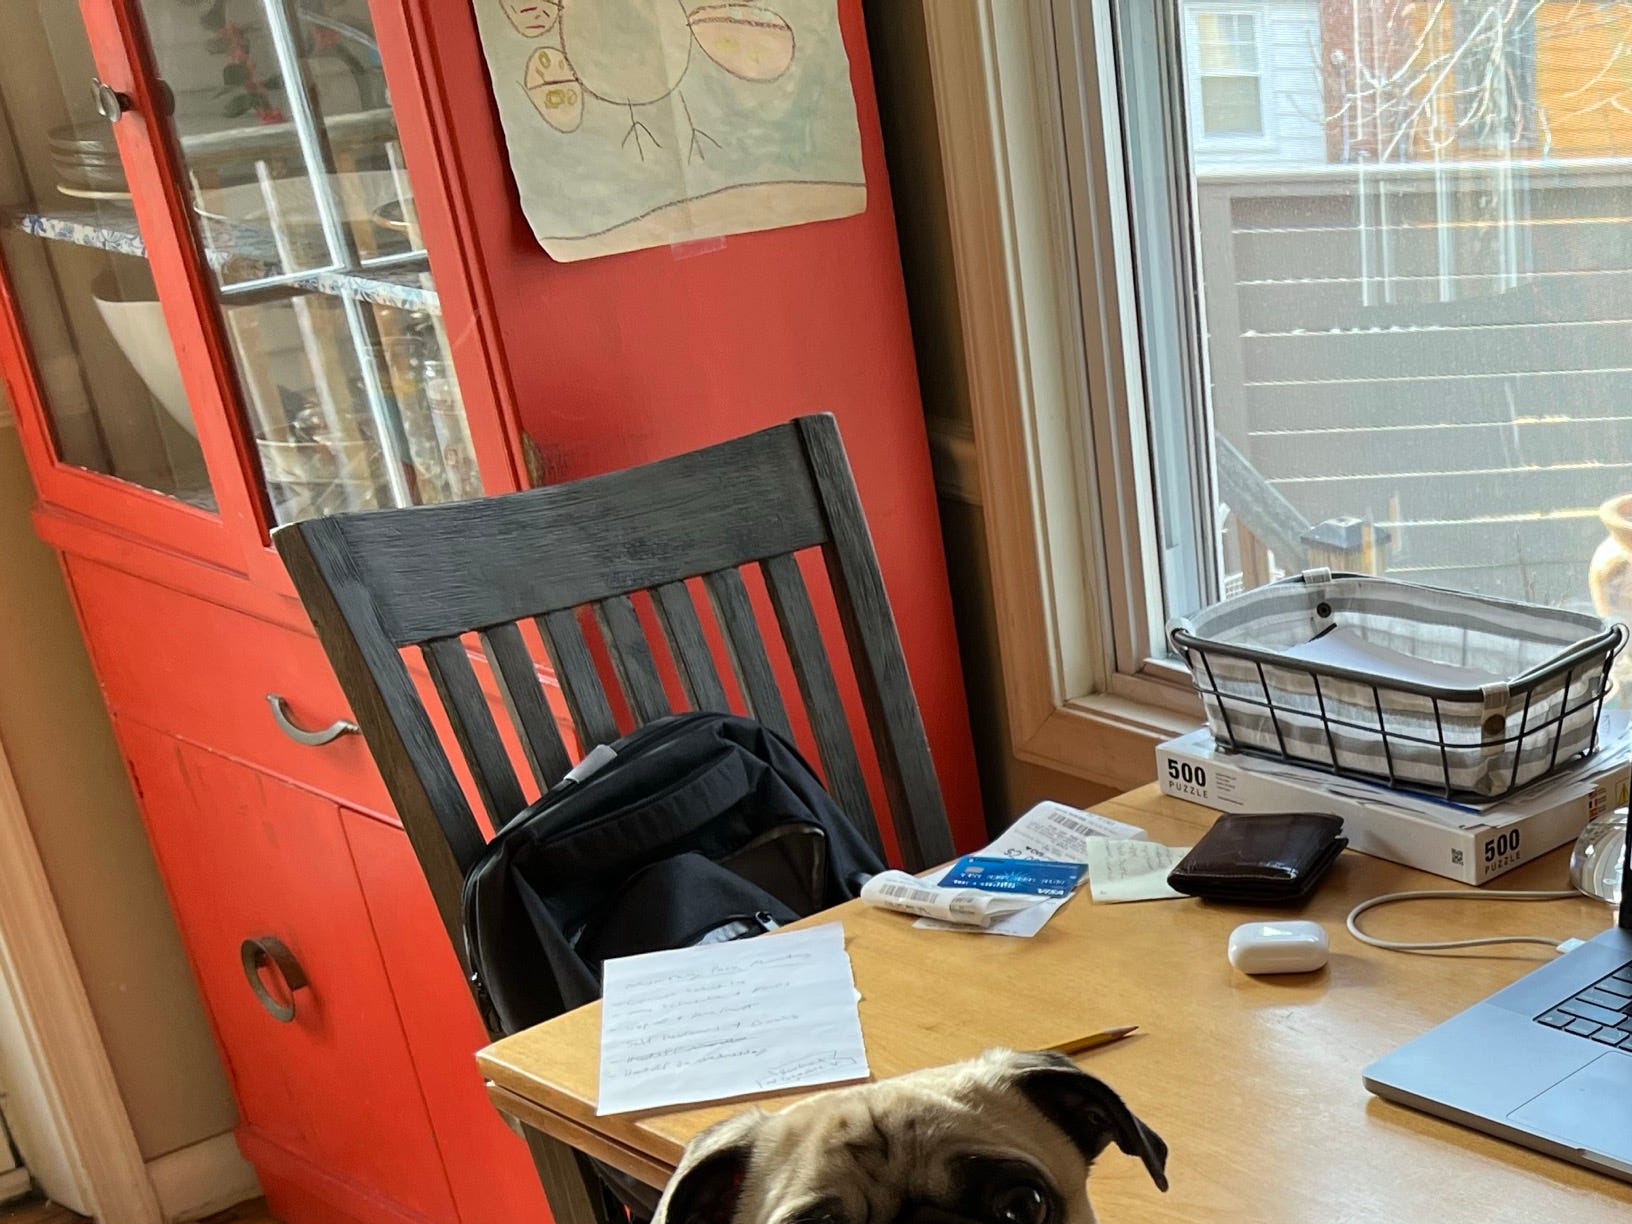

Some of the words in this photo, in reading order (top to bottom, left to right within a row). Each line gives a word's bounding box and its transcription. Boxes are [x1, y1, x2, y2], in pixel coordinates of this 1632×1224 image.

[1167, 758, 1206, 787] 500
[1169, 780, 1209, 799] PUZZLE
[1484, 828, 1520, 863] 500
[1485, 851, 1521, 875] PUZZLE
